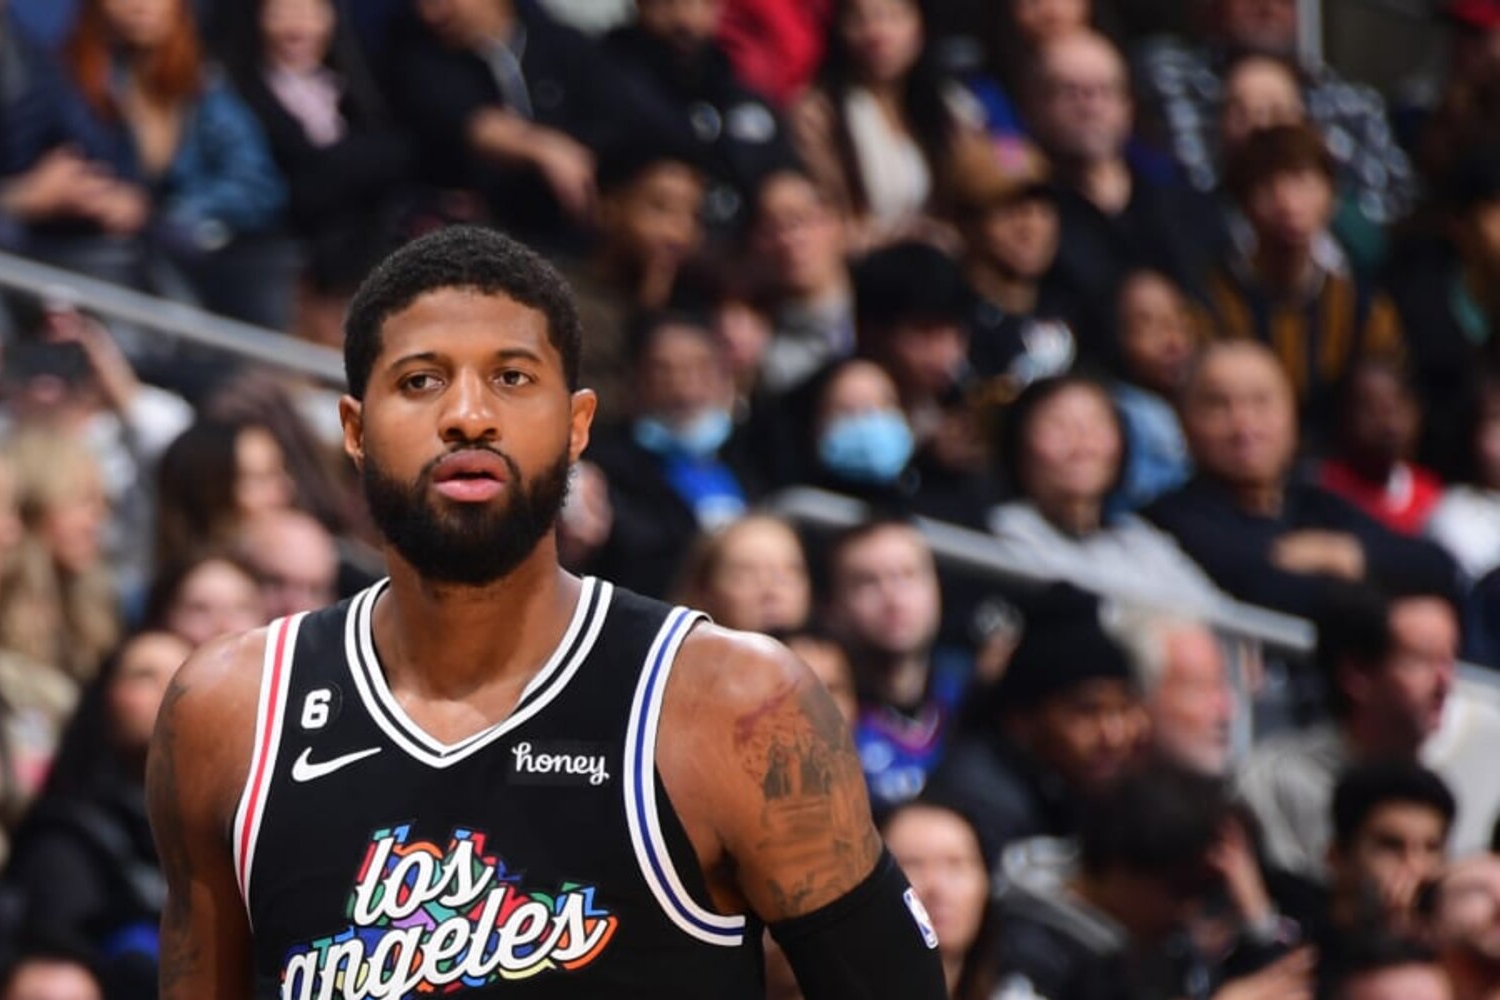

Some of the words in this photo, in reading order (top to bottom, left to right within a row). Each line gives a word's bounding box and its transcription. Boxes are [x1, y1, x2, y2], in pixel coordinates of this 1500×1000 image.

[301, 688, 331, 730] 6
[511, 741, 610, 786] honey
[355, 838, 494, 927] los
